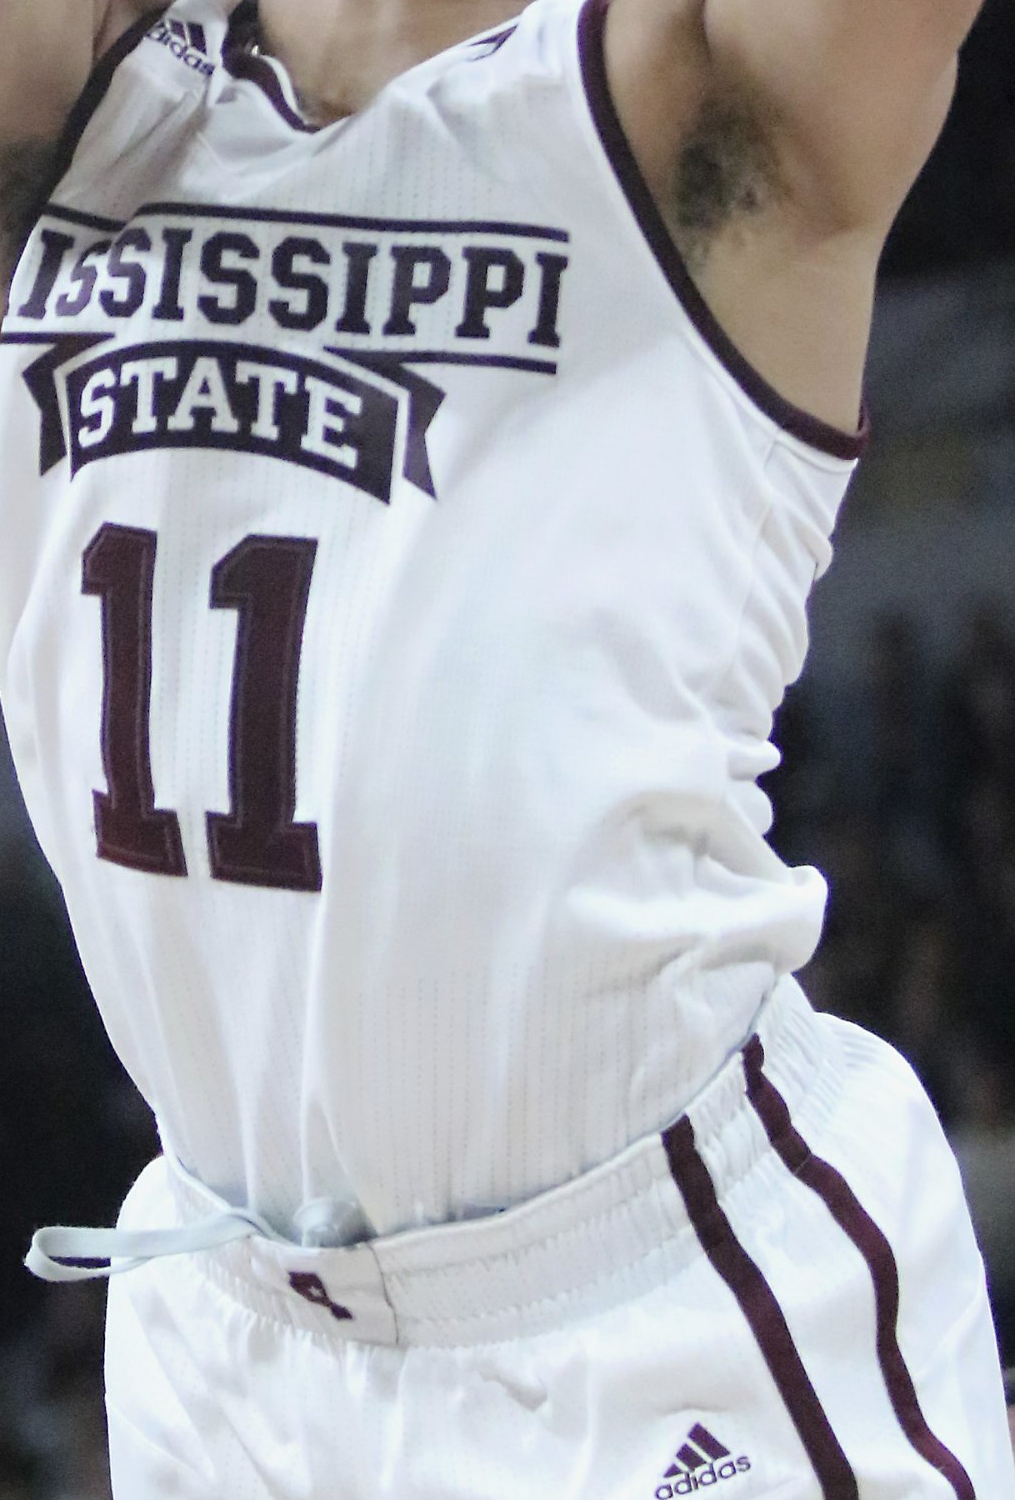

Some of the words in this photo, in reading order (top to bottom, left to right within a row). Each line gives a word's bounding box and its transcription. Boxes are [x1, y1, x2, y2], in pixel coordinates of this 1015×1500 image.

[146, 26, 215, 76] didas
[16, 226, 569, 349] ISSISSIPPI
[77, 356, 363, 470] STATE
[81, 520, 323, 893] 11
[654, 1455, 751, 1500] adidas
